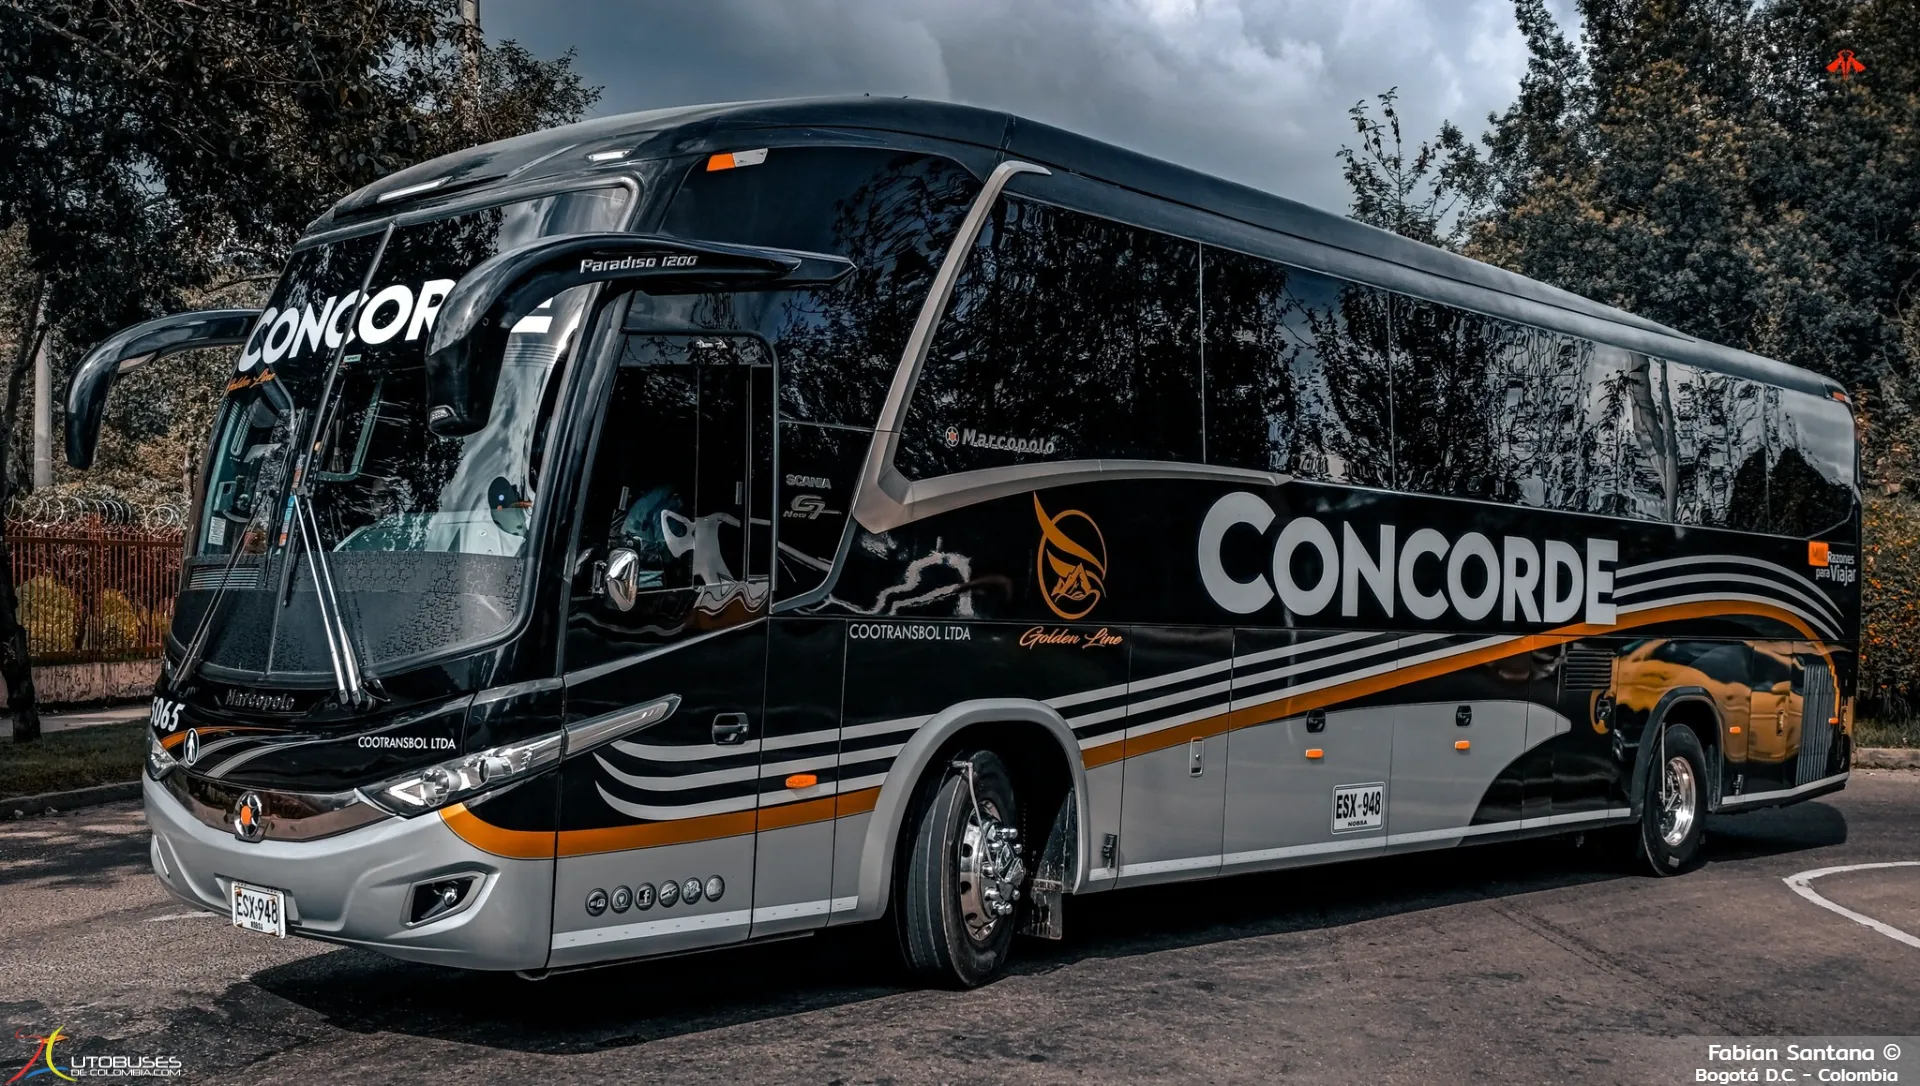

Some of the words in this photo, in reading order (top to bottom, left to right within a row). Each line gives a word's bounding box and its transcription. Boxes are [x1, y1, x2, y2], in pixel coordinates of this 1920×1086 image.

[580, 256, 657, 274] Paradiso
[661, 255, 699, 268] 1200
[961, 427, 1056, 455] Marcopolo
[785, 473, 832, 490] SCANIA
[1198, 491, 1619, 626] CONCORDE
[1827, 550, 1855, 565] Razones
[1815, 568, 1830, 580] para
[1830, 564, 1857, 587] Viajar
[849, 623, 942, 641] COOTRANSBOL
[944, 626, 971, 641] LTDA
[1019, 626, 1080, 650] Golden
[1081, 627, 1124, 650] Line
[224, 689, 296, 712] Marcopolo
[358, 736, 428, 750] COOTRANSBOL
[430, 738, 457, 750] LTDA
[1336, 791, 1381, 820] ESX-948
[1347, 819, 1368, 827] NOBSA
